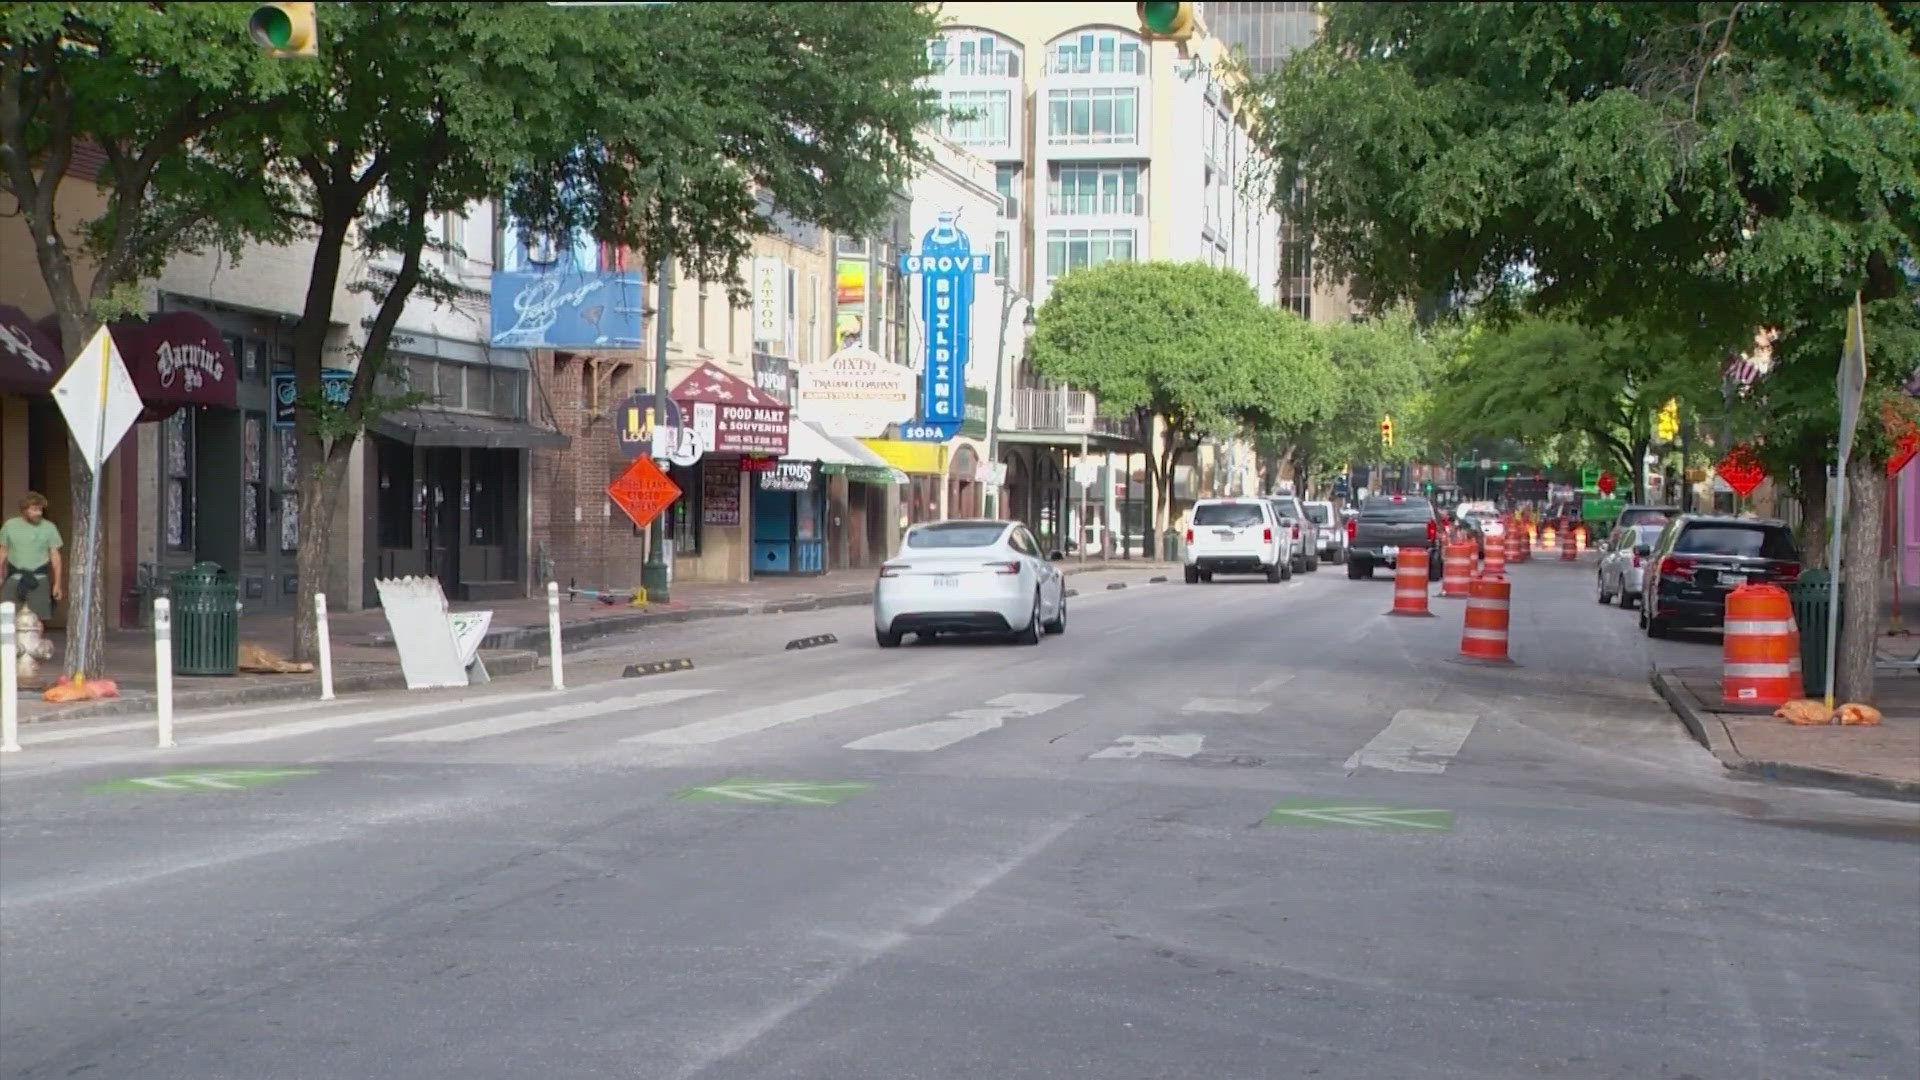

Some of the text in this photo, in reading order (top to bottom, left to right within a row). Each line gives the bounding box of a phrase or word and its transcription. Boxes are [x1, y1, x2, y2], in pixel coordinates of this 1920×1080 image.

[907, 256, 984, 271] GROVE
[761, 267, 774, 329] TATTOO
[935, 278, 950, 415] BUILDING
[156, 338, 224, 387] Darwin's
[723, 407, 784, 422] FOOD MART
[718, 421, 788, 434] & SOUVENIRS
[906, 427, 944, 439] SODA
